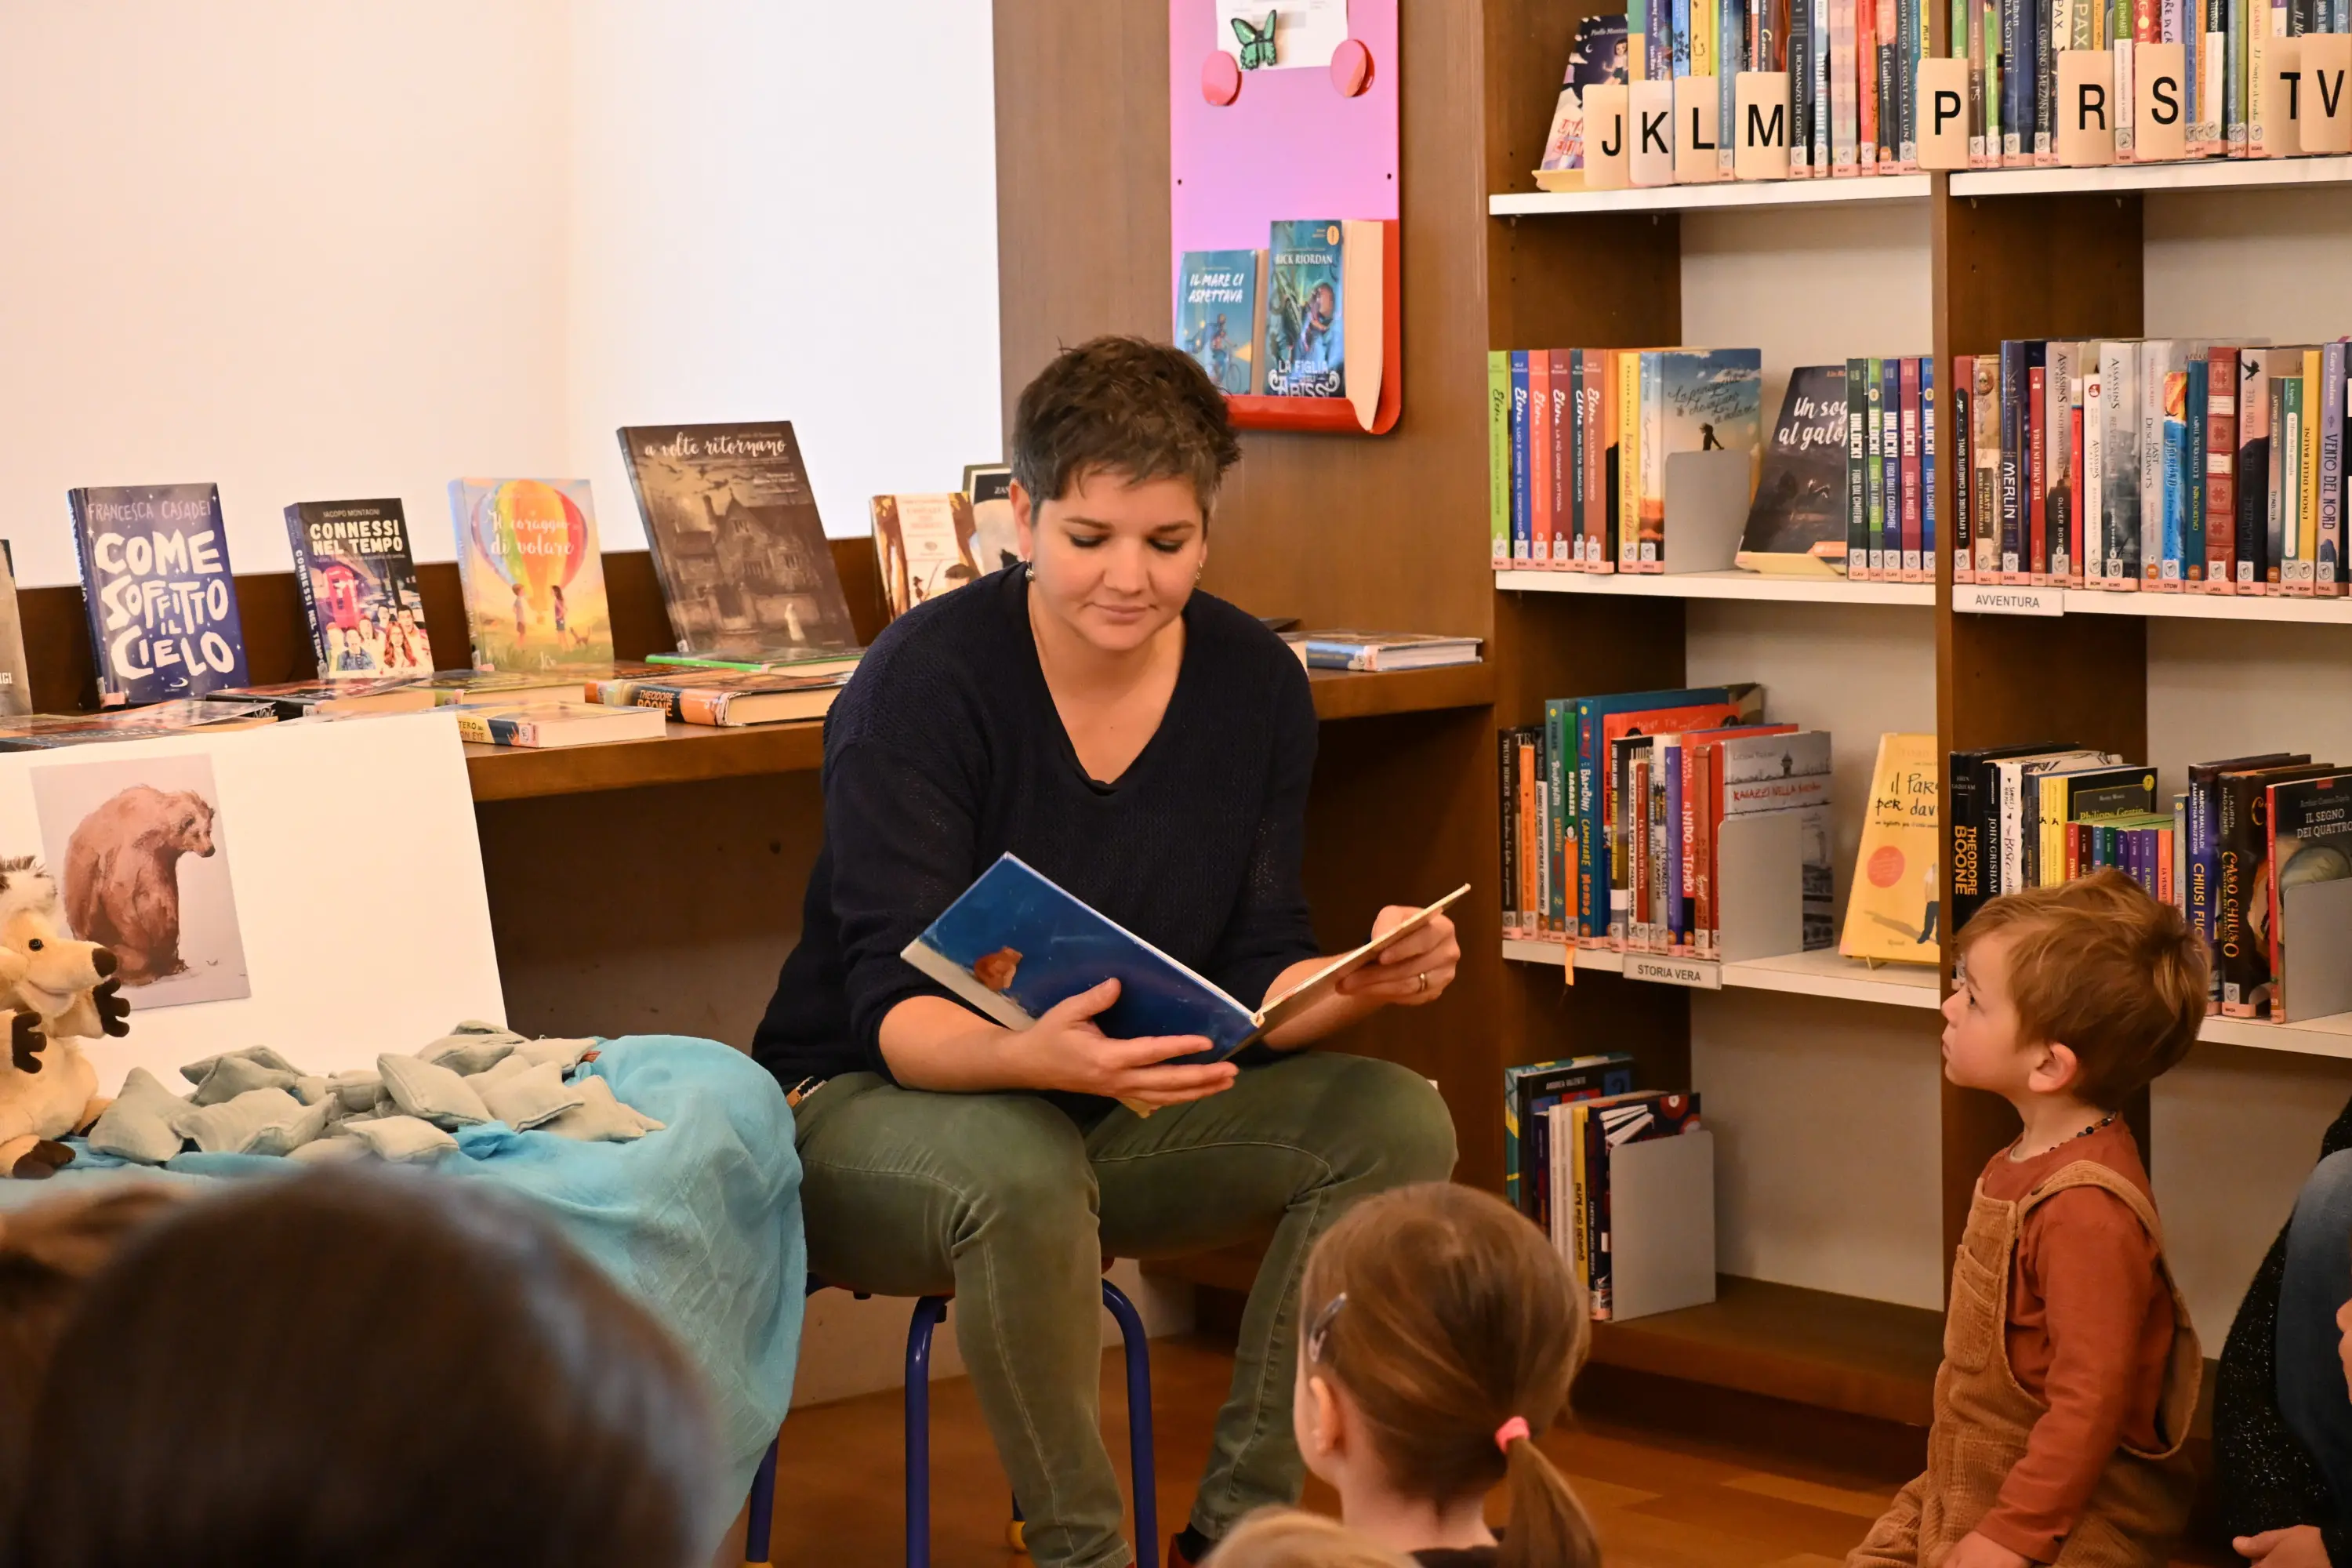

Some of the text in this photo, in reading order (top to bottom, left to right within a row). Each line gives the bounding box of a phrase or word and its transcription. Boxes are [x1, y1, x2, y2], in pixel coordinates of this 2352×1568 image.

[2054, 0, 2063, 29] PAX
[2074, 4, 2089, 46] PAX
[1795, 104, 1803, 114] DI
[1902, 103, 1908, 115] LA
[2079, 85, 2105, 130] R
[2151, 77, 2179, 125] S
[2280, 72, 2300, 119] T
[2317, 70, 2345, 117] V
[1693, 107, 1715, 149] L
[1748, 104, 1784, 147] M
[1935, 91, 1961, 135] P
[1602, 114, 1621, 156] J
[1642, 111, 1668, 153] K
[1275, 254, 1333, 265] RICK RIORDAN
[1189, 289, 1243, 303] ASPETTAVA
[1190, 273, 1244, 286] IL MARE CI
[1279, 360, 1328, 374] LA FIGLIA
[2328, 352, 2336, 372] Gary
[1515, 387, 1526, 424] Elena
[1534, 390, 1548, 426] Elena
[1552, 389, 1565, 426] Elena
[1587, 387, 1599, 426] Elena
[1794, 397, 1818, 419] Un
[660, 432, 699, 457] volte
[705, 435, 786, 458] ritornano
[1779, 422, 1799, 445] al
[1850, 413, 1862, 459] UNLOCK!
[1869, 409, 1879, 455] UNLOCK!
[1925, 409, 1935, 455] UNLOCK!
[1884, 412, 1897, 528] UNLOCK! FUGA DALLE CATACOMBE
[1904, 410, 1915, 519] UNLOCK! FUGA DAL MUSEO
[2033, 451, 2040, 459] IN
[2324, 434, 2339, 471] VENTO
[1852, 470, 1861, 484] FUGA
[1956, 457, 1965, 488] CHARLOTTE
[2323, 475, 2337, 495] DEL
[88, 500, 211, 521] FRANCESCA CASADEI
[1852, 496, 1861, 524] CIMITERO
[1957, 498, 1966, 530] AVVENTURE
[2322, 498, 2336, 530] NORD
[310, 519, 400, 539] CONNESSI
[313, 537, 403, 556] NEL TEMPO
[491, 534, 575, 556] di volare
[94, 529, 223, 576] COME
[296, 550, 313, 605] CONNESSI
[101, 575, 228, 635] SOFFITTO
[1976, 595, 2039, 608] AVVENTURA
[161, 619, 182, 635] IL
[111, 625, 234, 680] CIELO
[639, 689, 674, 702] THEODORE
[1580, 769, 1592, 811] BAMBINI
[2296, 821, 2352, 839] DEI QUATTRO
[2306, 808, 2345, 823] IL SEGNO
[1682, 811, 1693, 892] NIDO TEMPO
[1955, 825, 1966, 895] BOONE
[1966, 826, 1976, 895] THEODORE
[1988, 817, 1998, 893] JOHN GRISHAM
[1582, 874, 1592, 916] MONDO
[2194, 863, 2205, 906] CHIUSI
[2221, 851, 2239, 958] CASO CHIUSO
[1638, 965, 1700, 982] STORIA VERA
